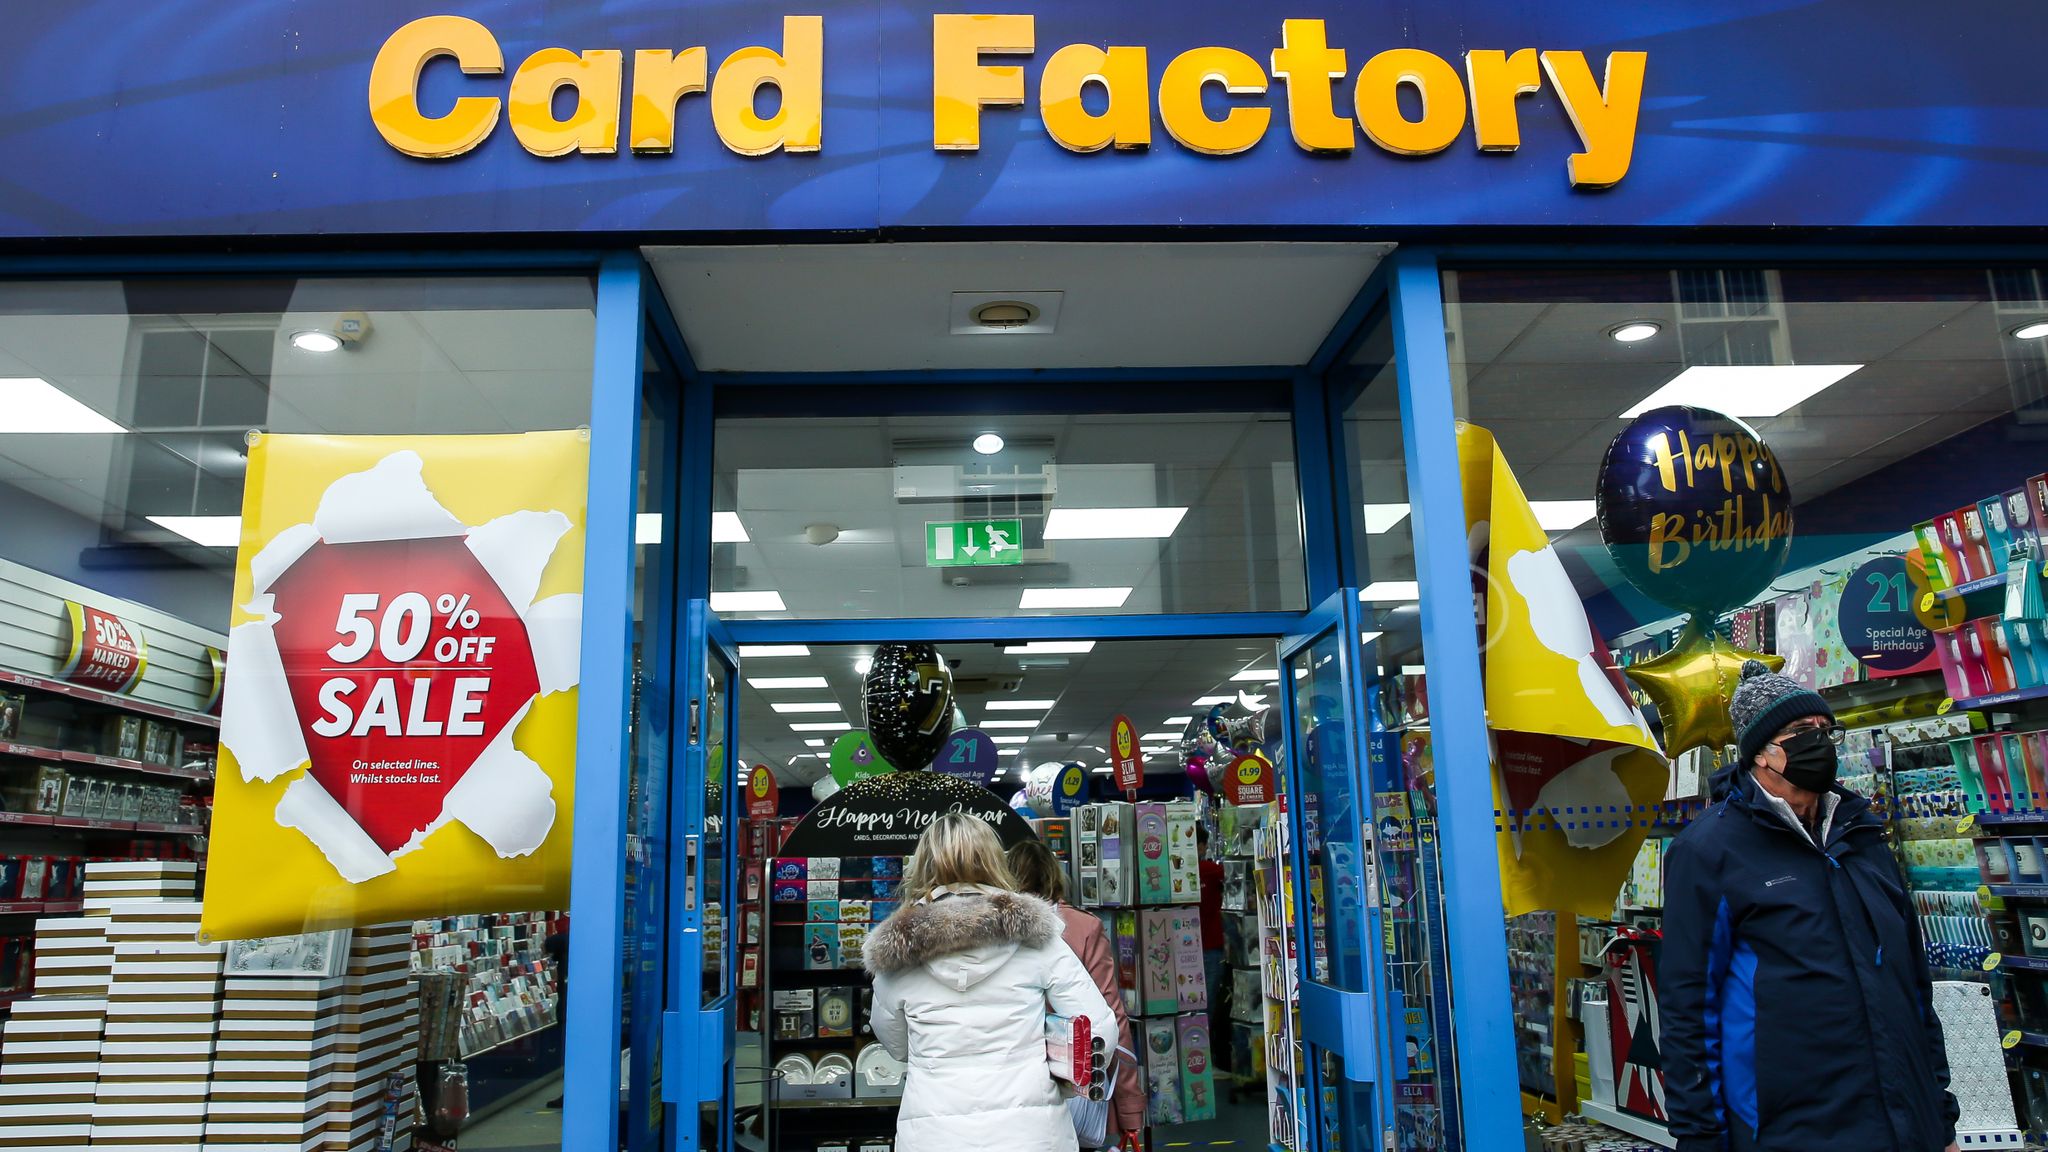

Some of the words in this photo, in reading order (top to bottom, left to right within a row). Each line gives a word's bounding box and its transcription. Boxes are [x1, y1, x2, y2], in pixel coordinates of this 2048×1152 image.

[369, 15, 823, 158] Card
[933, 14, 1647, 188] Factory
[1652, 429, 1782, 493] Happy
[1648, 493, 1795, 574] Birthday
[1865, 572, 1909, 613] 21
[326, 592, 481, 664] 50%
[1865, 627, 1904, 640] Special
[1907, 626, 1928, 640] Age
[118, 638, 132, 652] OFF
[434, 636, 496, 663] OFF
[1872, 638, 1925, 653] Birthdays
[91, 647, 130, 669] MARKED
[83, 663, 126, 683] PRICE
[311, 677, 491, 738] SALE
[950, 738, 978, 763] 21
[352, 759, 368, 770] On
[370, 759, 412, 770] selected
[414, 759, 440, 770] lines.
[1239, 767, 1260, 777] £1.99
[350, 773, 383, 784] Whilst
[385, 773, 417, 784] stocks
[419, 773, 441, 784] last.
[855, 771, 870, 779] Kids
[972, 771, 985, 779] Age
[1238, 785, 1264, 795] SQUARE
[817, 806, 894, 831] Happy
[854, 834, 872, 842] CARDS,
[908, 833, 918, 841] AND
[1403, 1086, 1423, 1097] ELLA
